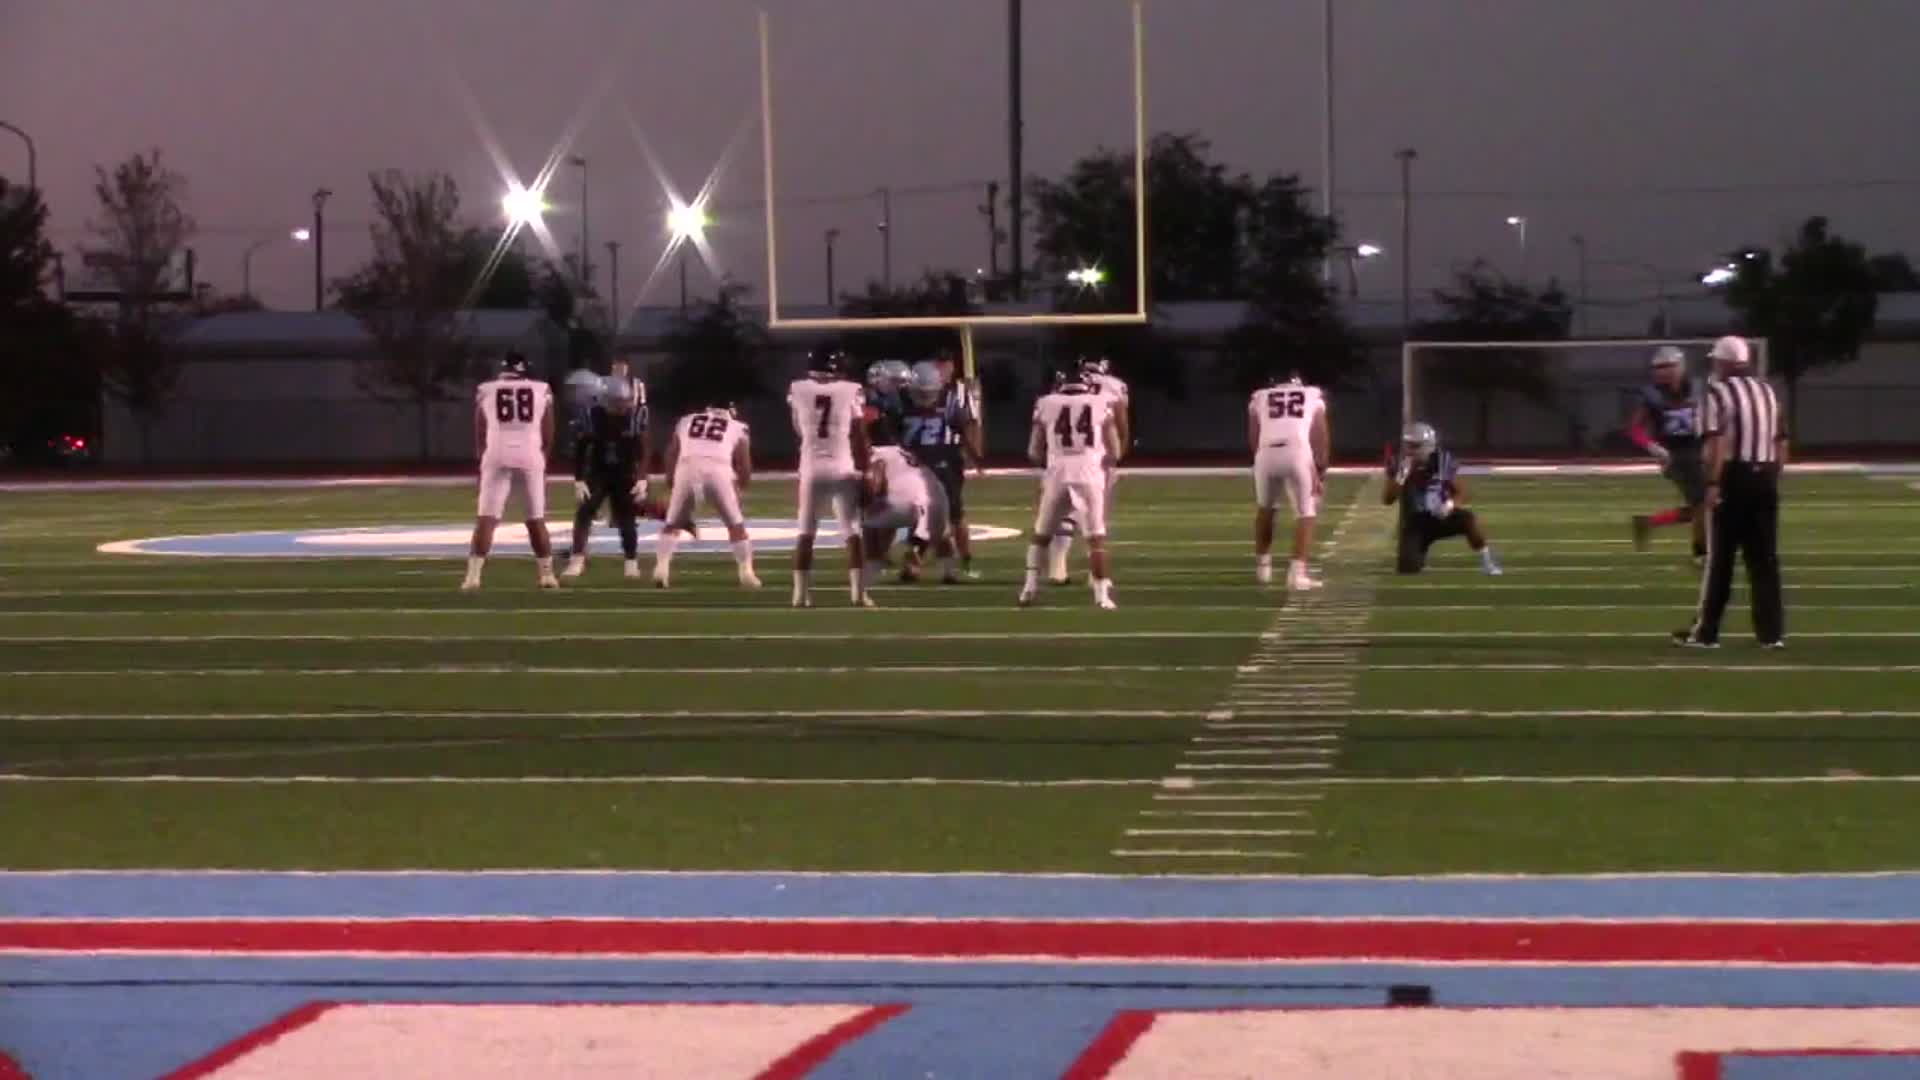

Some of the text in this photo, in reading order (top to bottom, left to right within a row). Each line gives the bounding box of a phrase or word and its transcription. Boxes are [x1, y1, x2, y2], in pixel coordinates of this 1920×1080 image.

[496, 388, 534, 423] 68
[815, 395, 831, 439] 7
[1267, 391, 1305, 419] 52
[688, 415, 728, 442] 62
[902, 415, 943, 446] 72
[1054, 404, 1096, 447] 44
